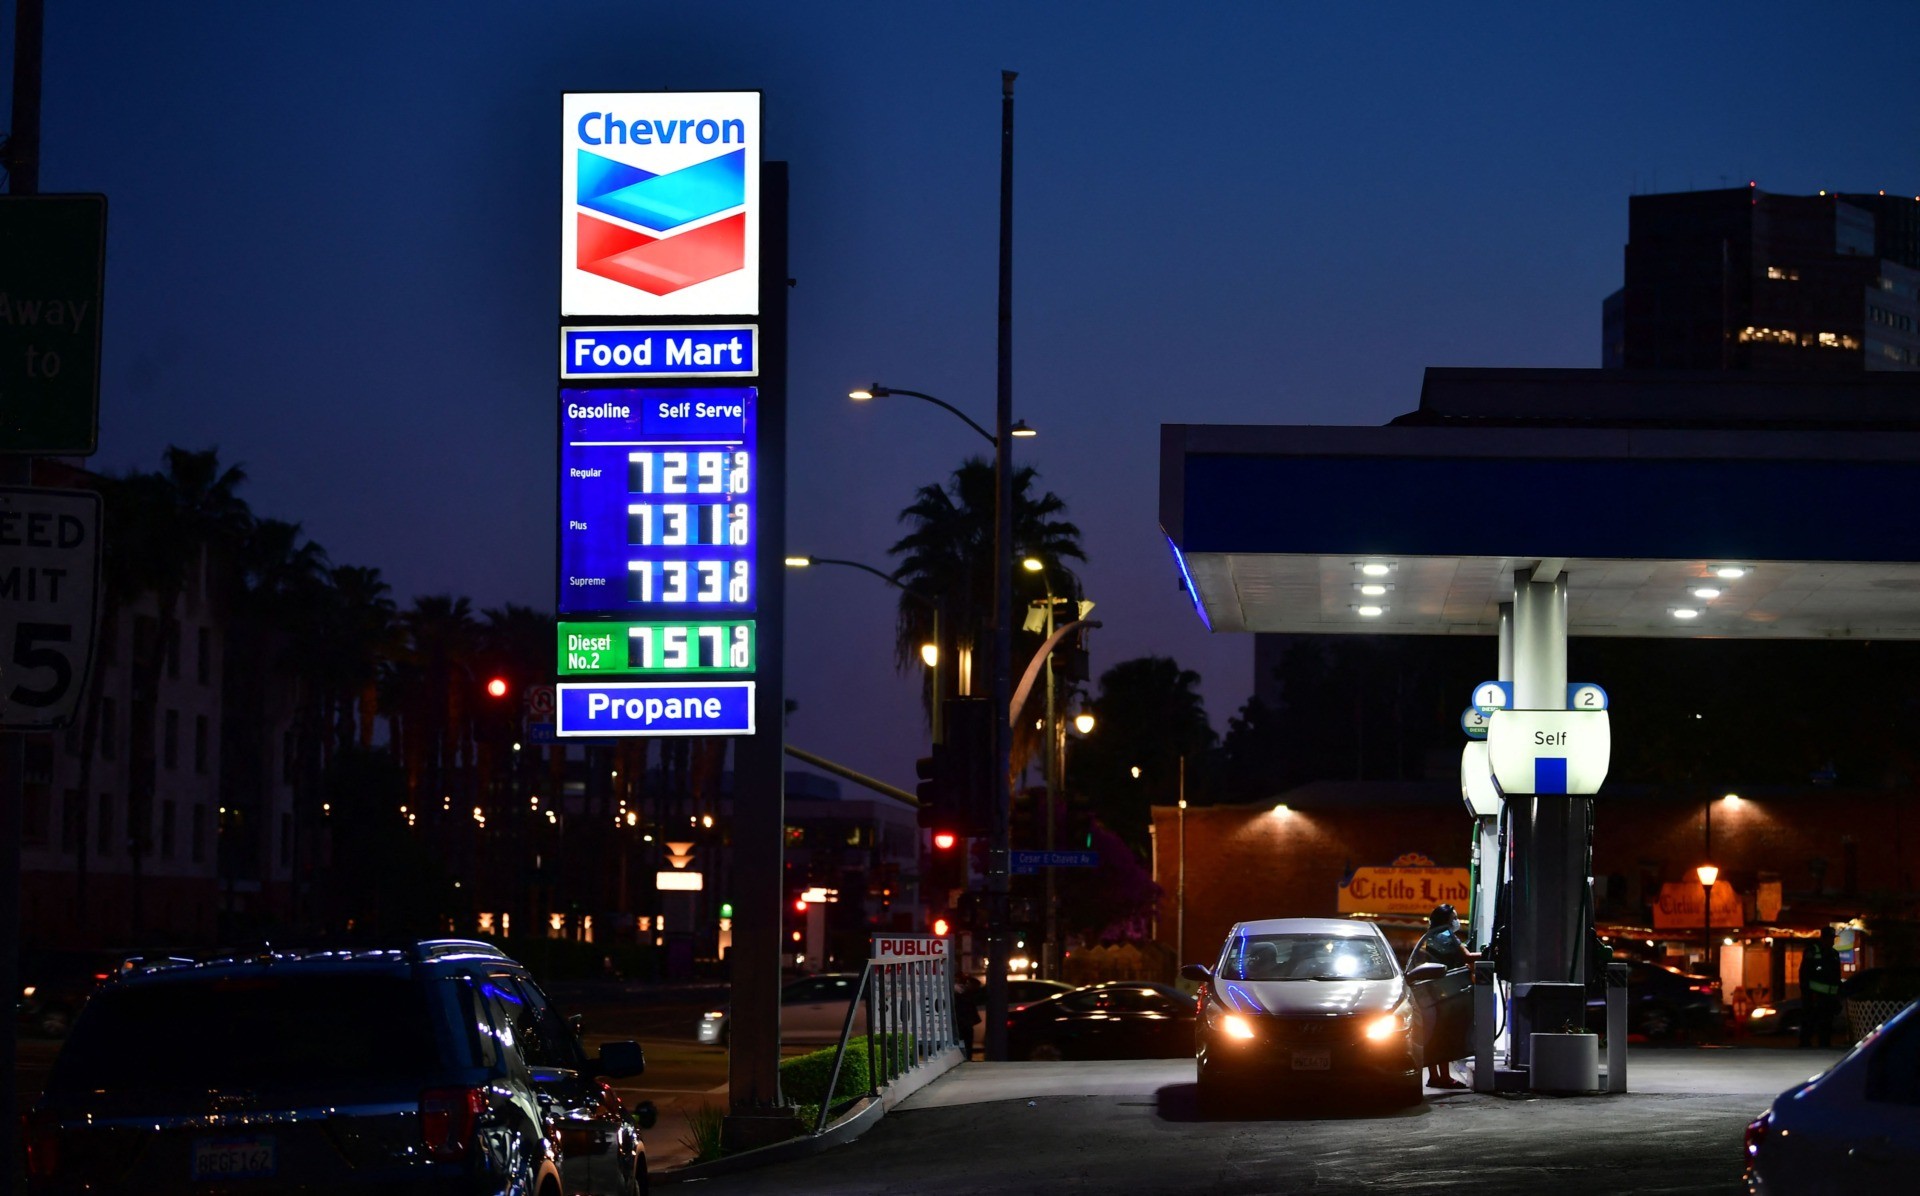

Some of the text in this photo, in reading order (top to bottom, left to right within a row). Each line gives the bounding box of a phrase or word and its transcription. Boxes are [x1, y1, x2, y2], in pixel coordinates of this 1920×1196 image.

[577, 111, 745, 146] Chevron
[24, 343, 61, 378] to
[575, 336, 742, 367] Food Mart
[568, 403, 631, 419] Gasoline
[658, 402, 742, 418] Self Serve
[570, 468, 602, 479] Regular
[628, 452, 722, 493] 729
[0, 511, 85, 549] EED
[569, 520, 588, 530] Plus
[628, 504, 722, 545] 731
[0, 566, 67, 603] MIT
[570, 576, 606, 587] Supreme
[628, 561, 722, 602] 733
[568, 634, 611, 651] Diesel
[628, 627, 722, 668] 757
[10, 622, 73, 708] 5
[568, 653, 600, 669] No.2
[1487, 690, 1493, 704] 1
[1584, 692, 1595, 706] 2
[588, 693, 722, 725] Propane
[1473, 712, 1483, 725] 3
[1534, 731, 1567, 746] Self
[1350, 877, 1468, 902] Cielito Lind
[881, 940, 943, 956] PUBLIC
